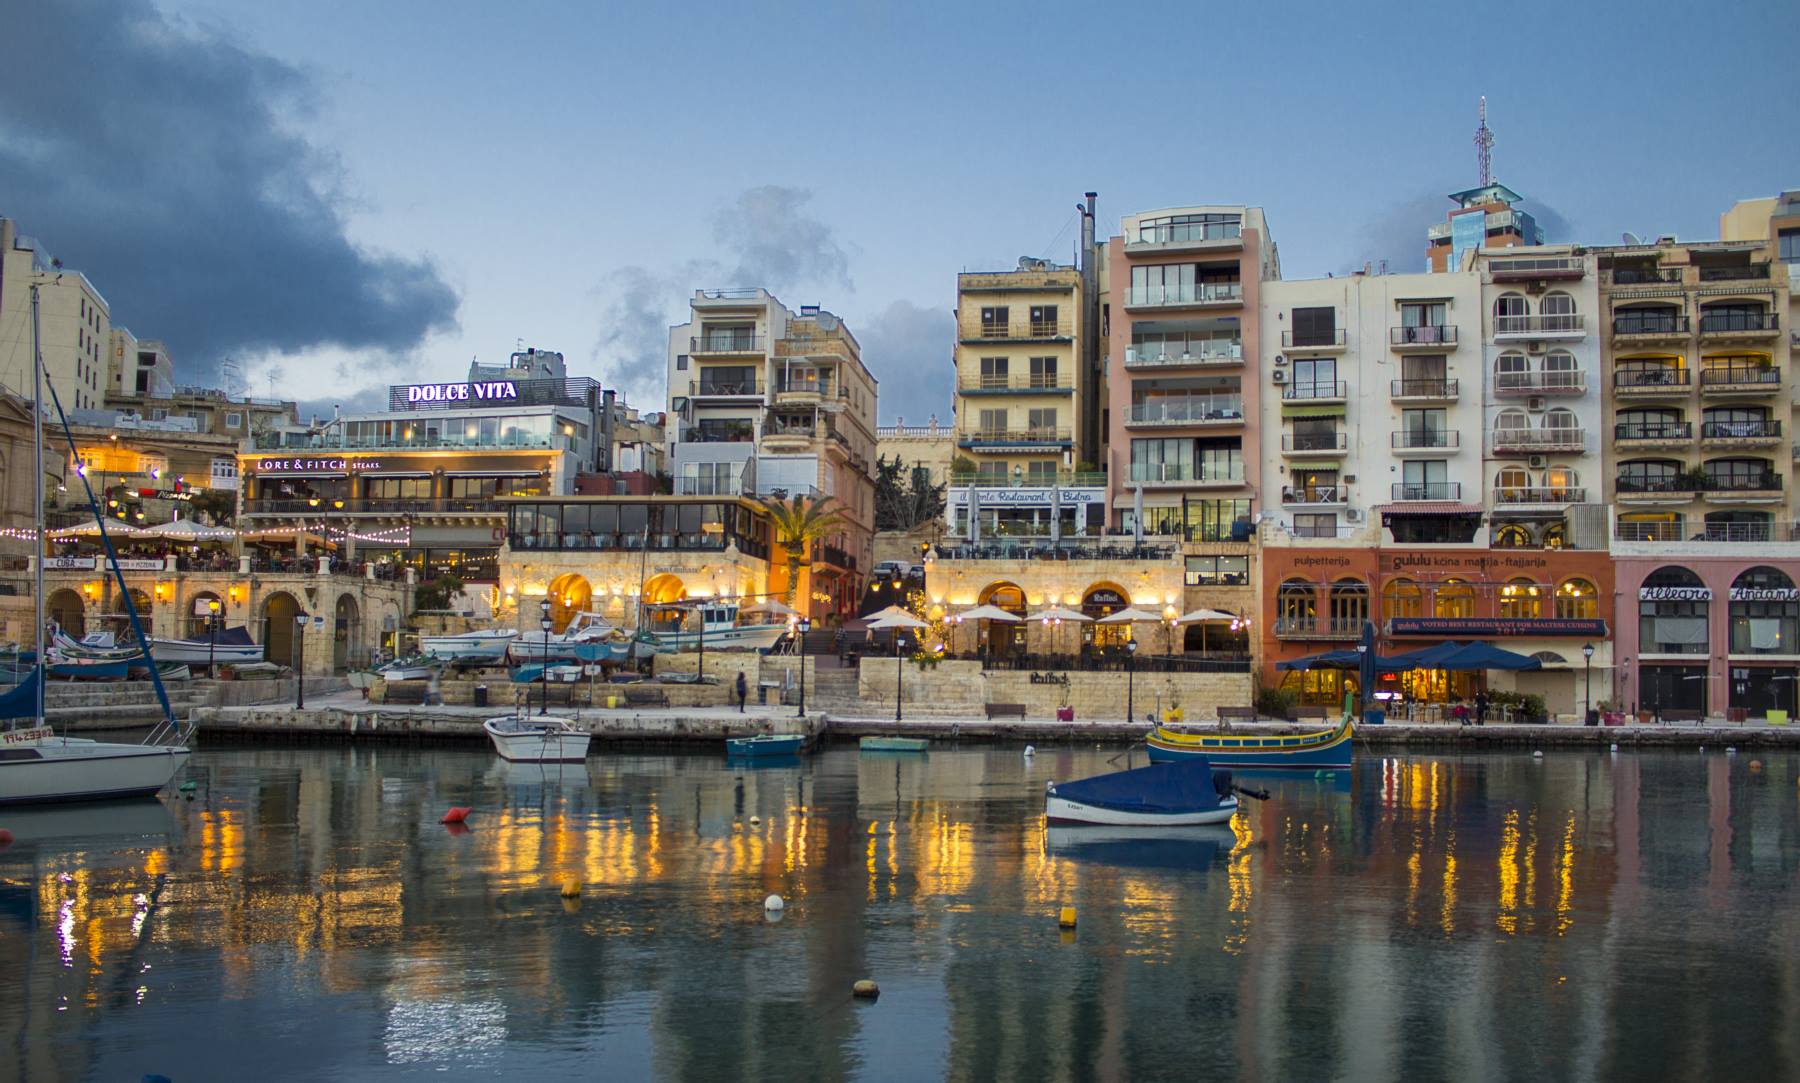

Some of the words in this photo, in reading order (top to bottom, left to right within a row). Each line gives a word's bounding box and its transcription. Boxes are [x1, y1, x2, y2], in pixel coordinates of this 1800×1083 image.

[409, 384, 469, 401] DOLCE
[473, 382, 517, 399] VITA
[257, 460, 290, 469] LORE
[294, 459, 303, 469] &
[307, 460, 347, 469] FITCH
[999, 491, 1045, 501] Restaurant
[1063, 490, 1091, 501] Bistro
[56, 559, 76, 568] CUBA
[1294, 556, 1350, 567] pulpetterija
[1393, 552, 1431, 570] gululu
[1464, 556, 1499, 569] maija
[1505, 556, 1546, 568] ftajjarija
[1641, 587, 1711, 600] Allegro
[1731, 587, 1800, 600] Andante
